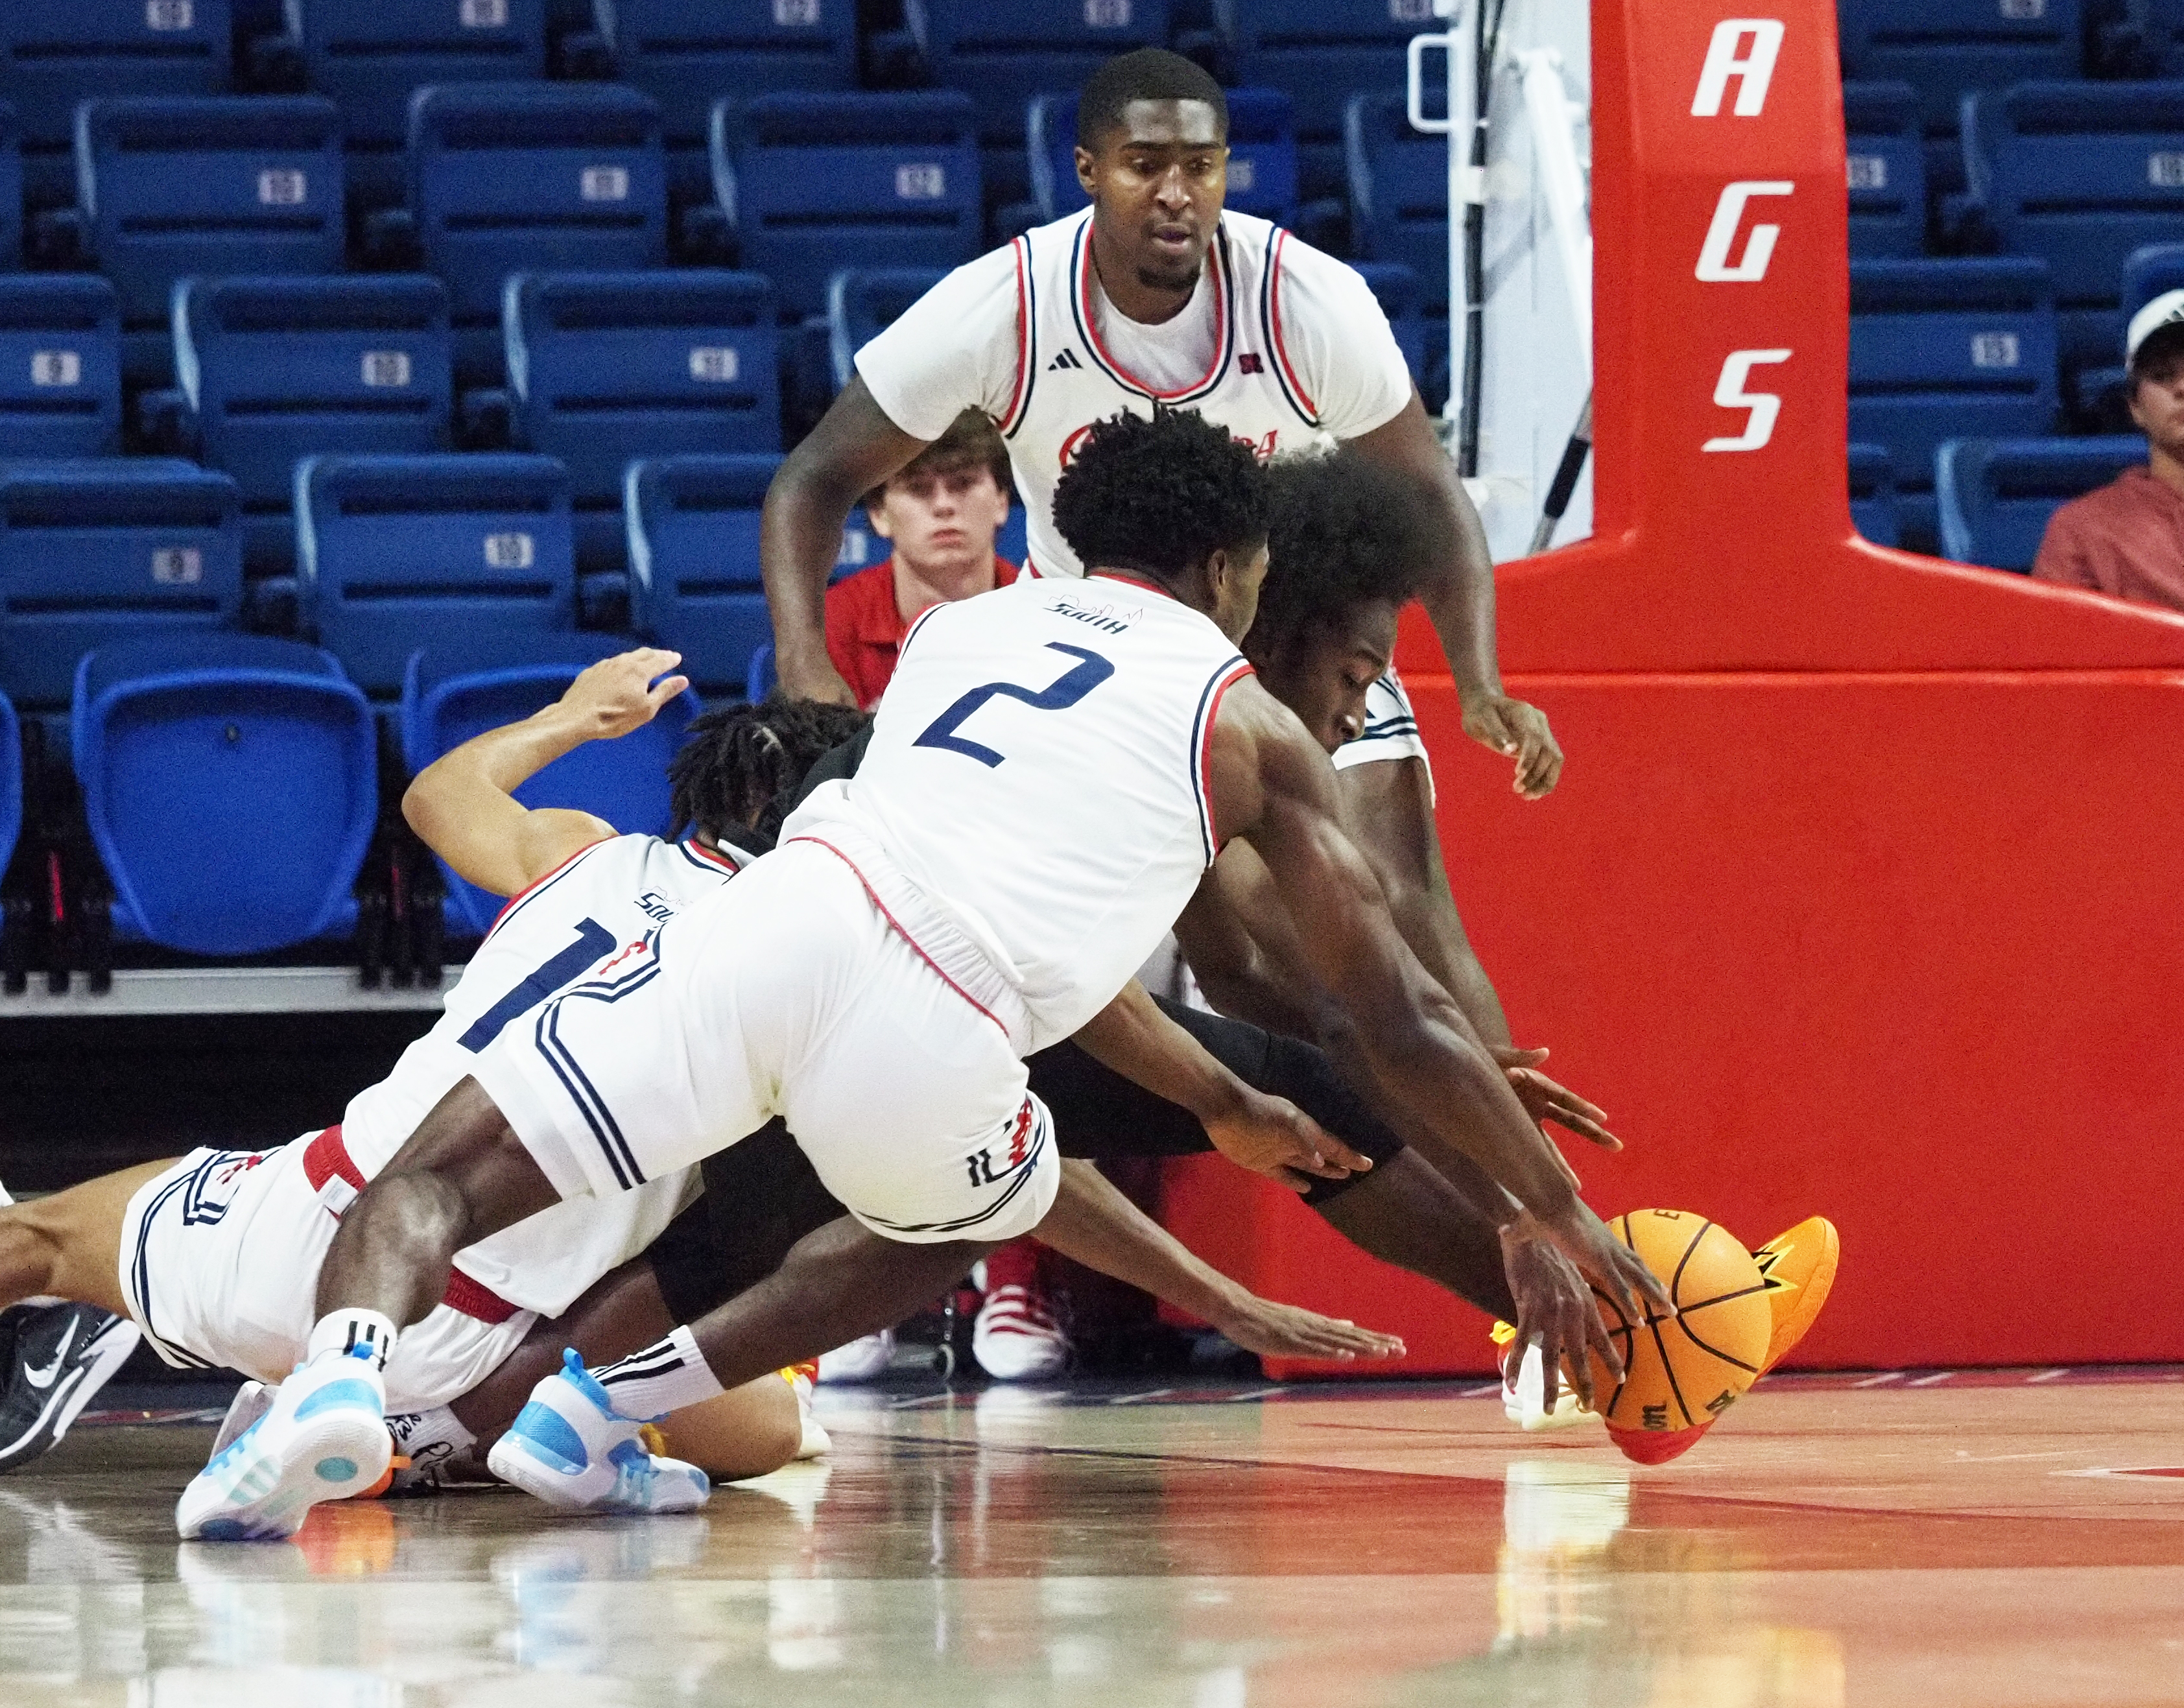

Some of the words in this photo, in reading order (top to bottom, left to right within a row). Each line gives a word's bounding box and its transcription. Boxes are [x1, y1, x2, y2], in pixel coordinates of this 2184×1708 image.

[1042, 602, 1129, 635] SOUTH
[910, 641, 1115, 768] 2
[634, 892, 676, 923] SOU
[456, 916, 617, 1054] 1
